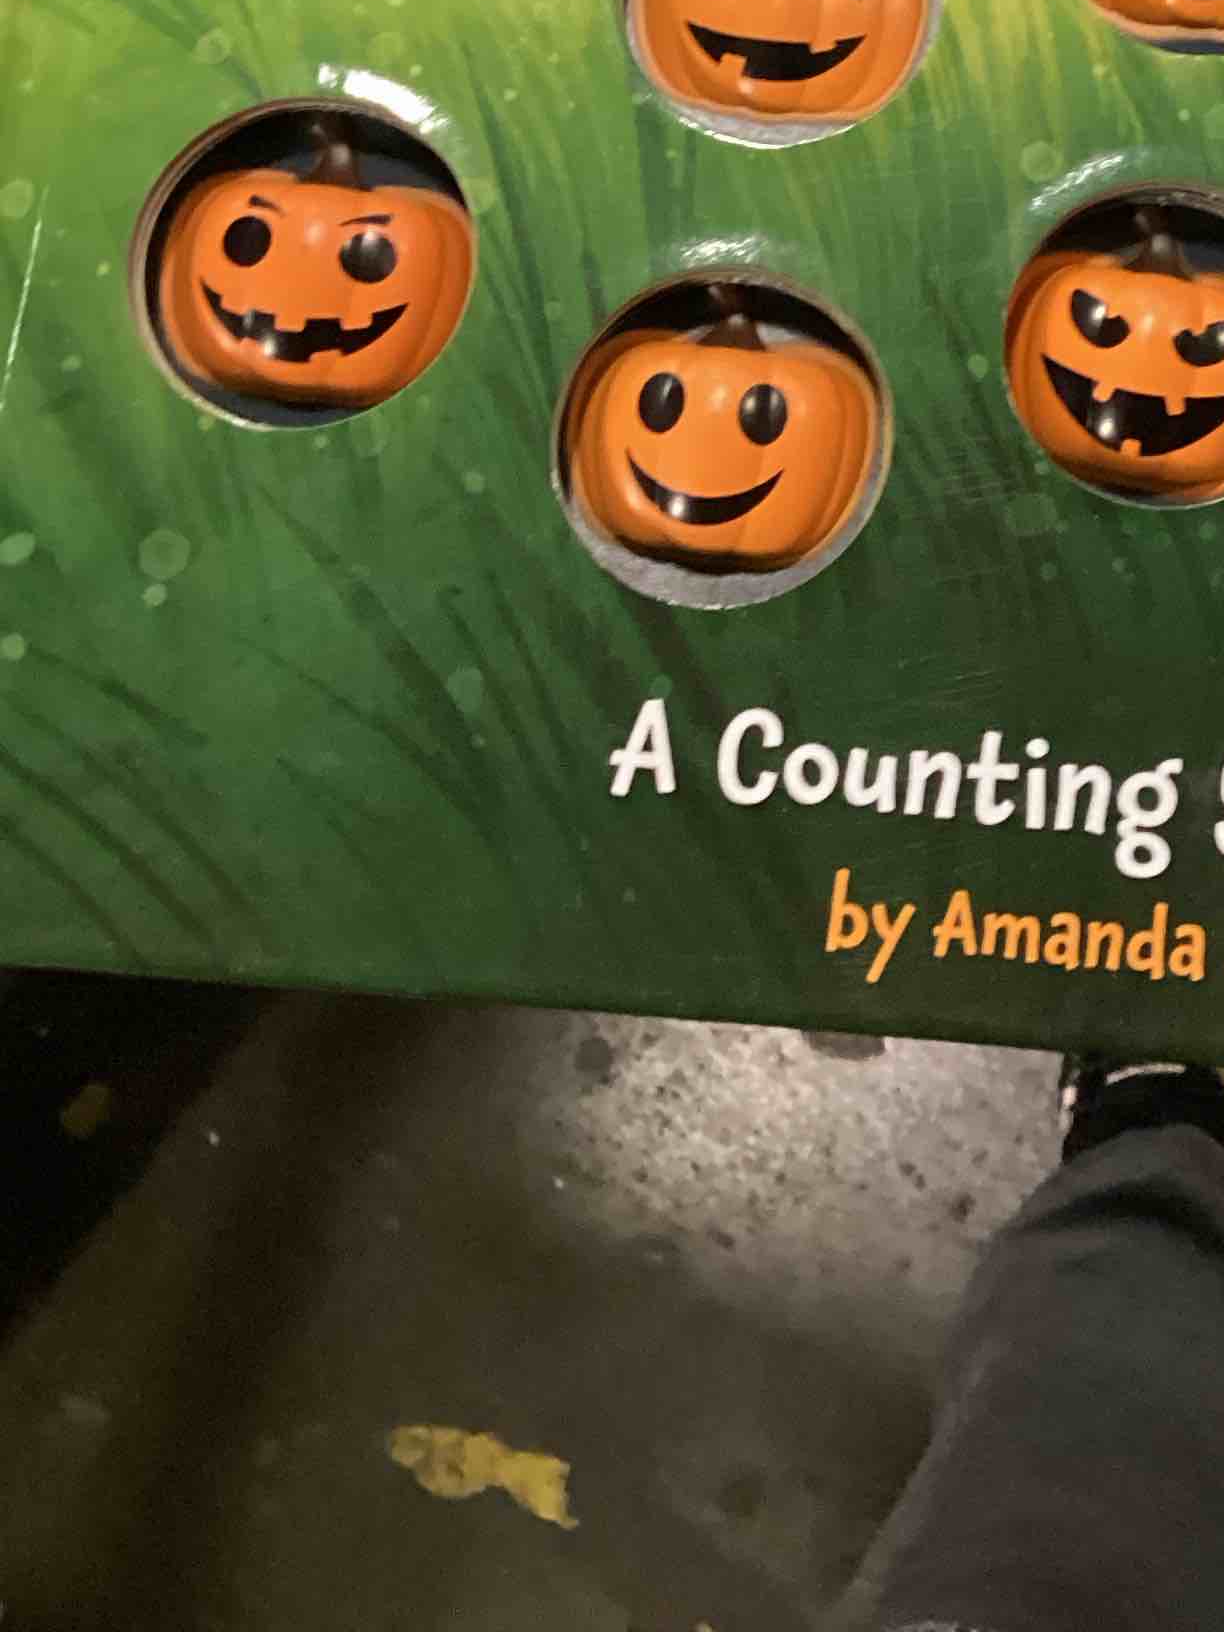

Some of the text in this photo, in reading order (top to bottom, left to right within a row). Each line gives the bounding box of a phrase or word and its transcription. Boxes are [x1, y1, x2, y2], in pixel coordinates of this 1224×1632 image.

[609, 697, 677, 797] A
[717, 706, 1184, 879] Counting
[825, 867, 917, 984] by
[932, 888, 1207, 981] Amanda
